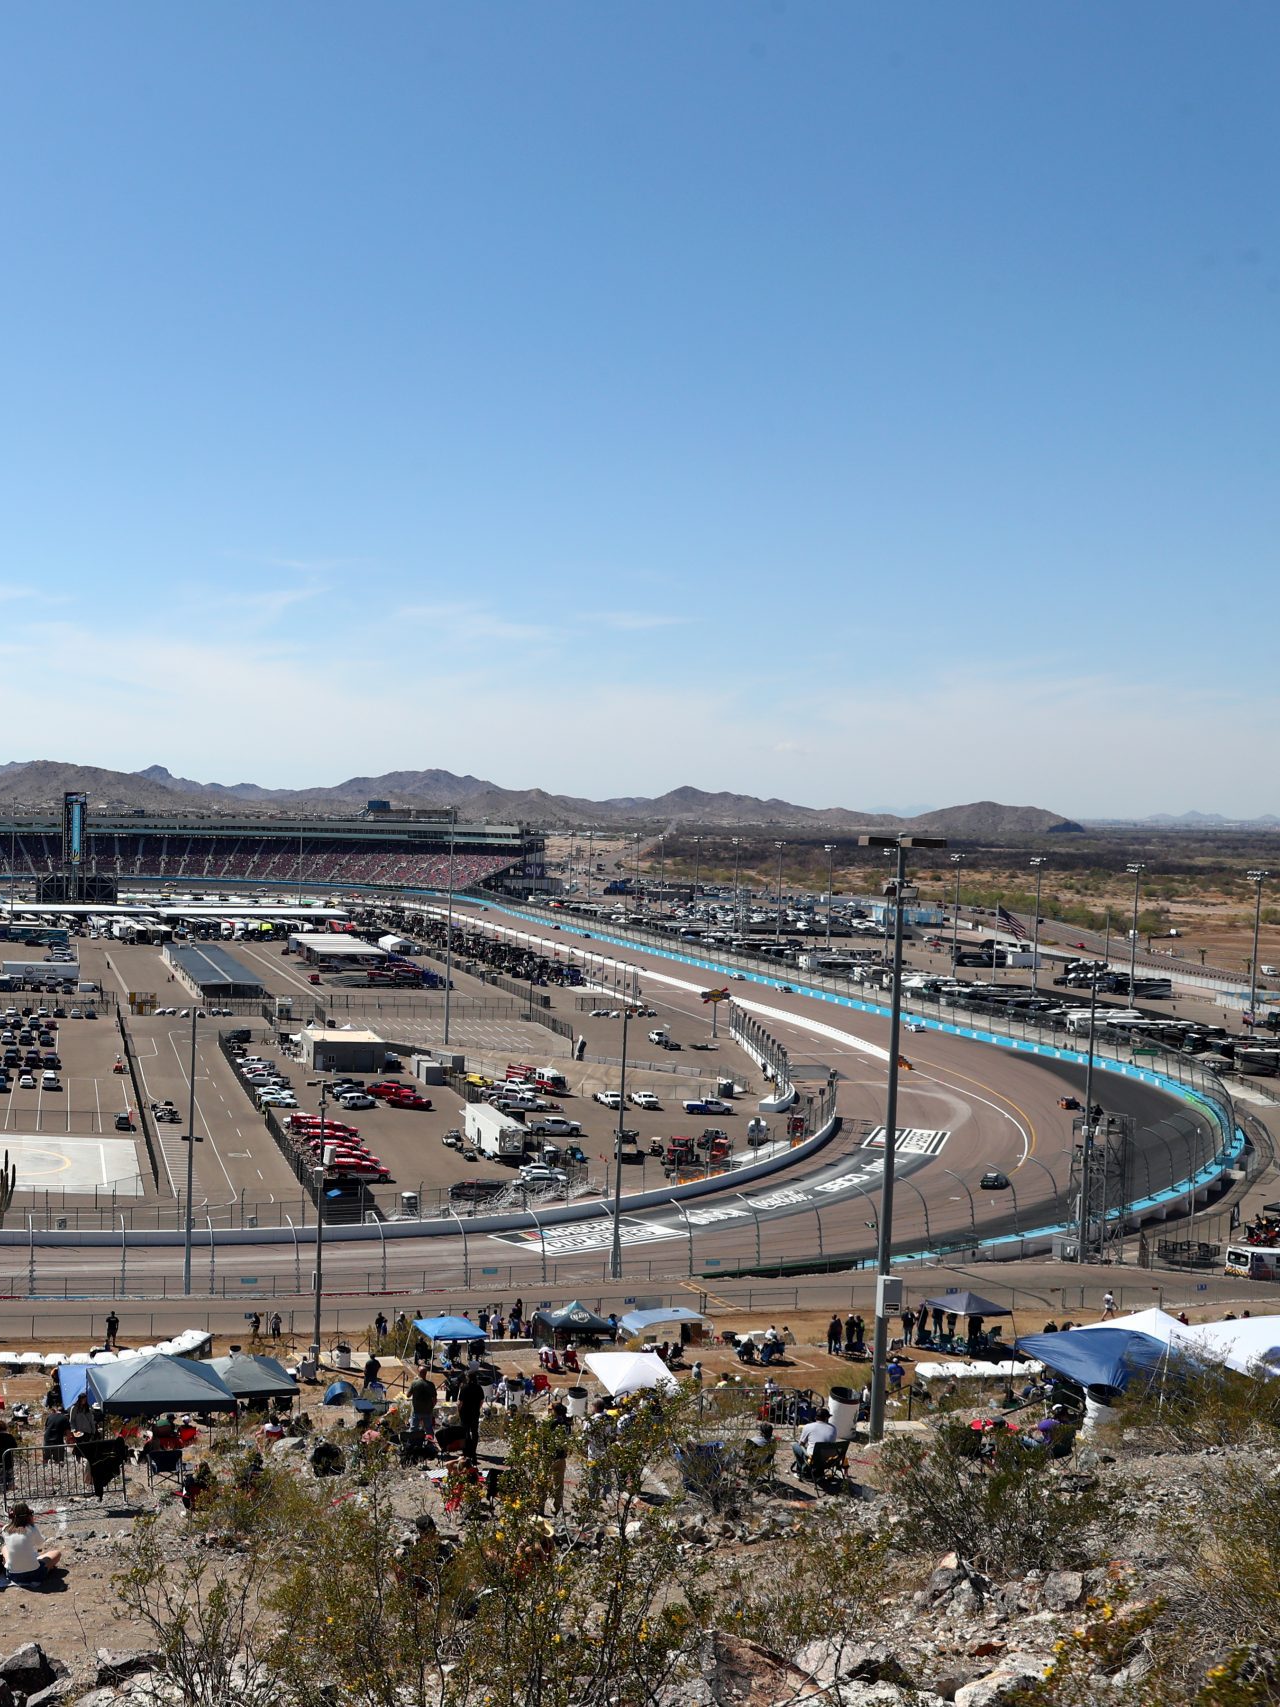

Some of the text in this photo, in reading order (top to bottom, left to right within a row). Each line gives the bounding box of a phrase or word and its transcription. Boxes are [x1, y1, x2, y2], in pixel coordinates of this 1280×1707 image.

[525, 864, 542, 877] ally
[814, 1173, 870, 1193] GEICO
[544, 1219, 628, 1238] NASCAR
[546, 1238, 587, 1250] CUP
